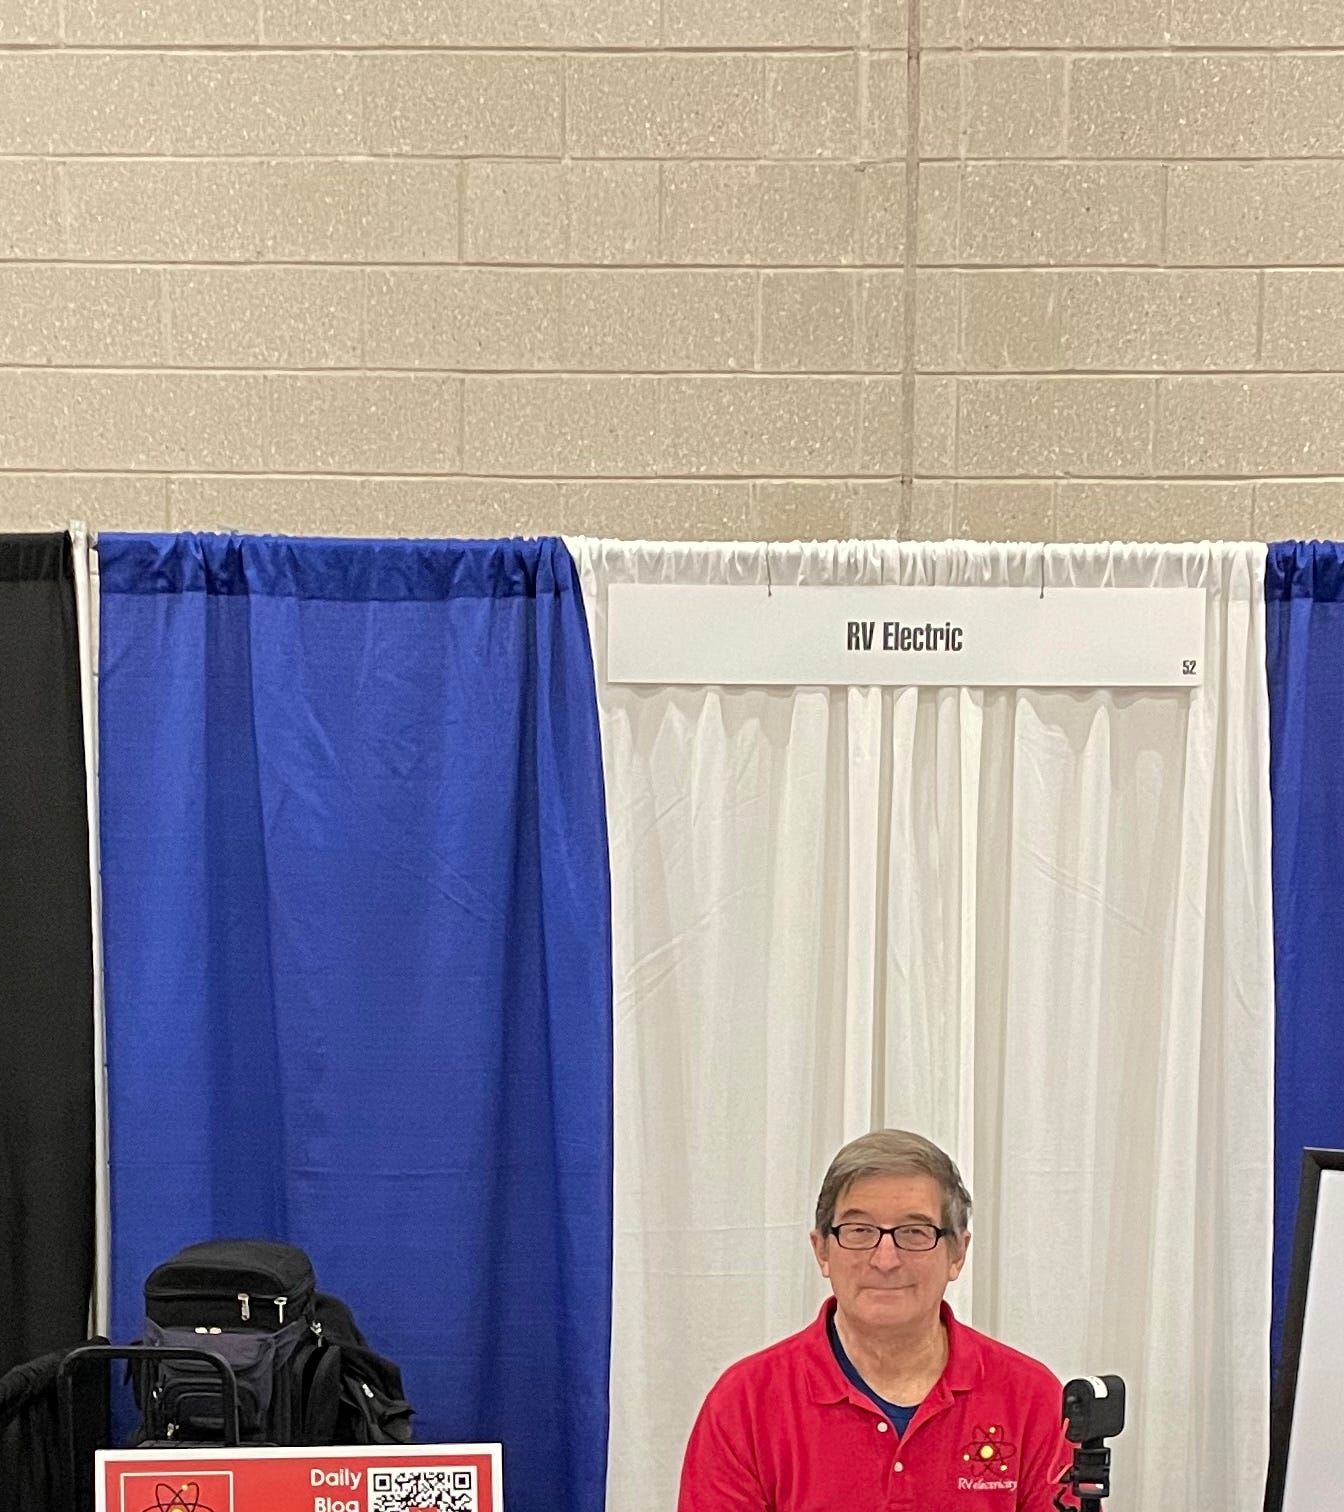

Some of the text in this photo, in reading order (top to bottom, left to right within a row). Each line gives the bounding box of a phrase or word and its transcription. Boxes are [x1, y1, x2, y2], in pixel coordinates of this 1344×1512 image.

[847, 621, 963, 652] RV Electric
[1182, 660, 1196, 676] 52
[311, 1468, 362, 1491] Daily
